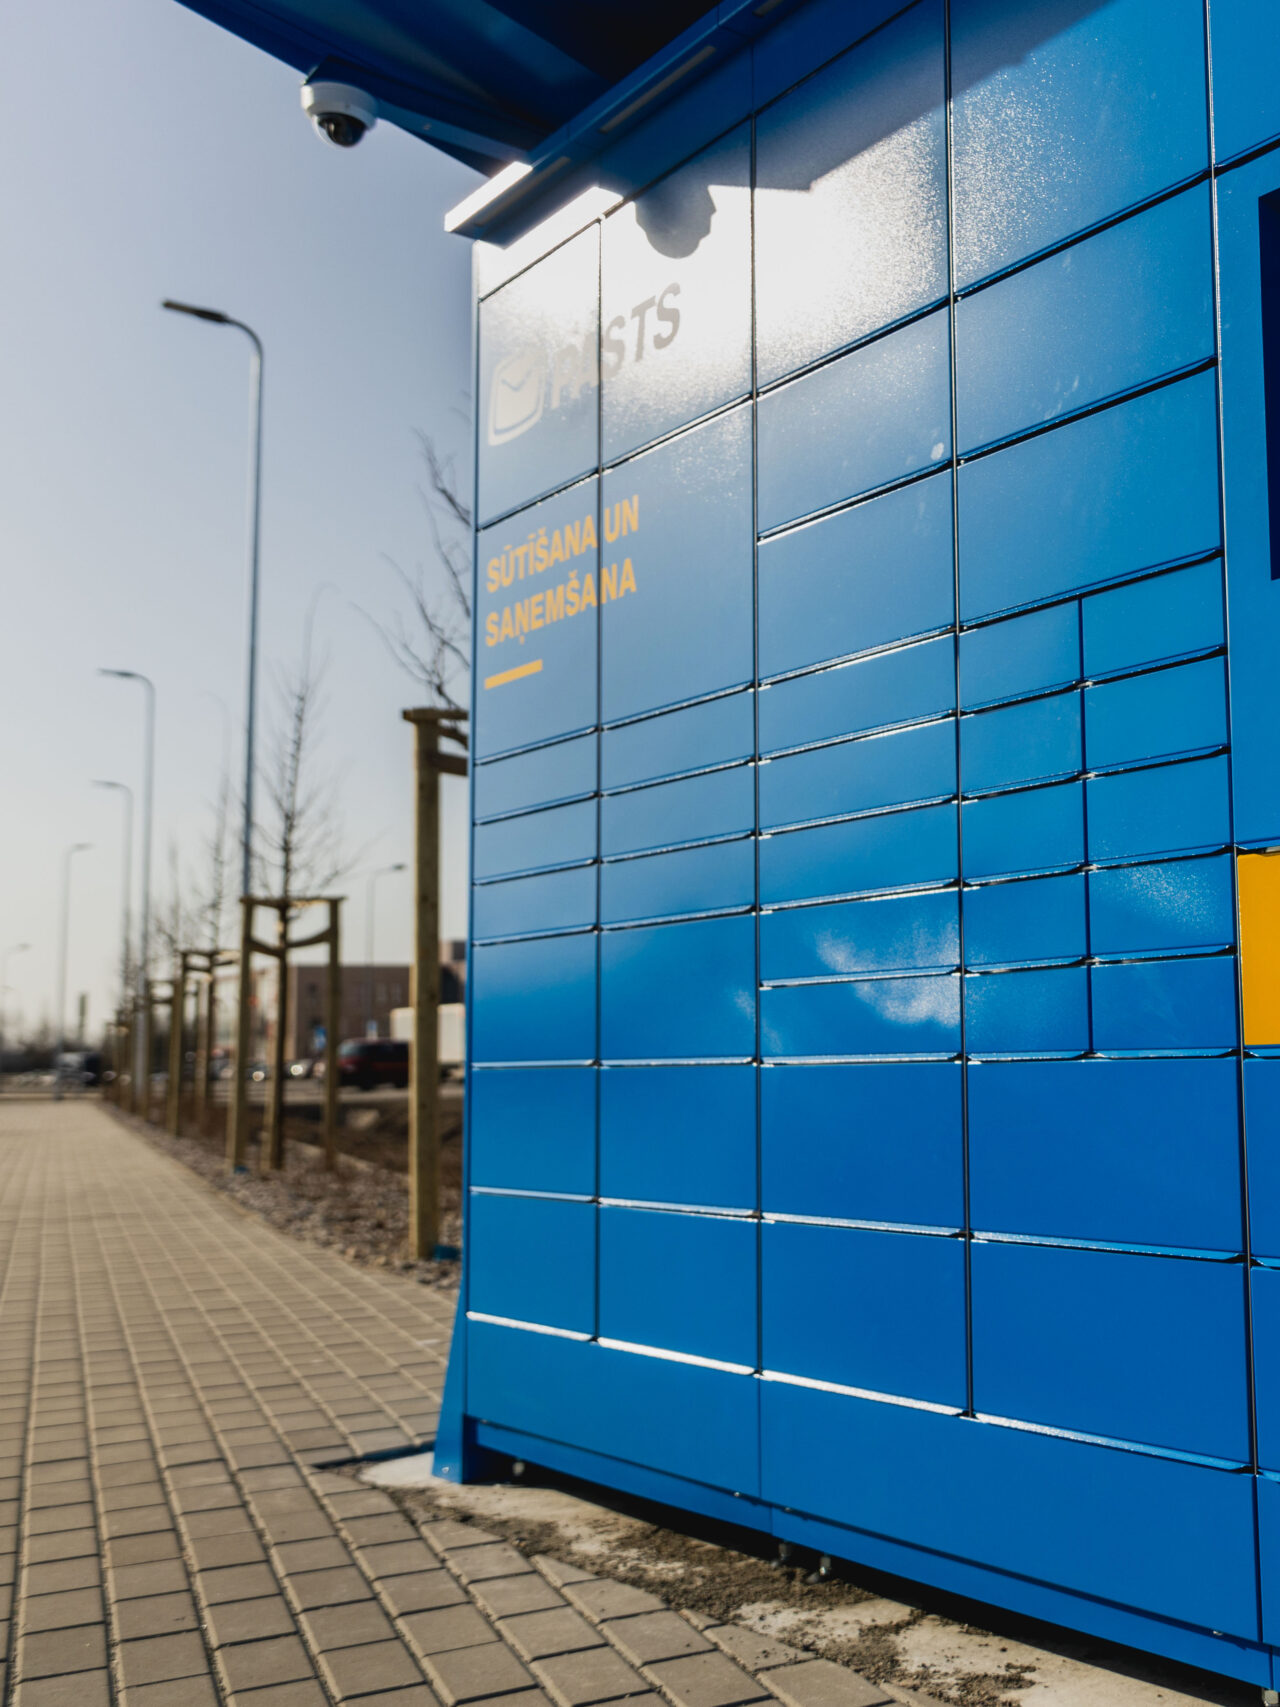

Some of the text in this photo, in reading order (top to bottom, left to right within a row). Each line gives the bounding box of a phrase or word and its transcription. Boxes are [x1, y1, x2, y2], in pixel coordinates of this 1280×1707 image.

[551, 282, 681, 409] PASTS
[486, 495, 639, 593] SŪTĪŠANA UN
[485, 557, 637, 647] SAŅEMŠANA
